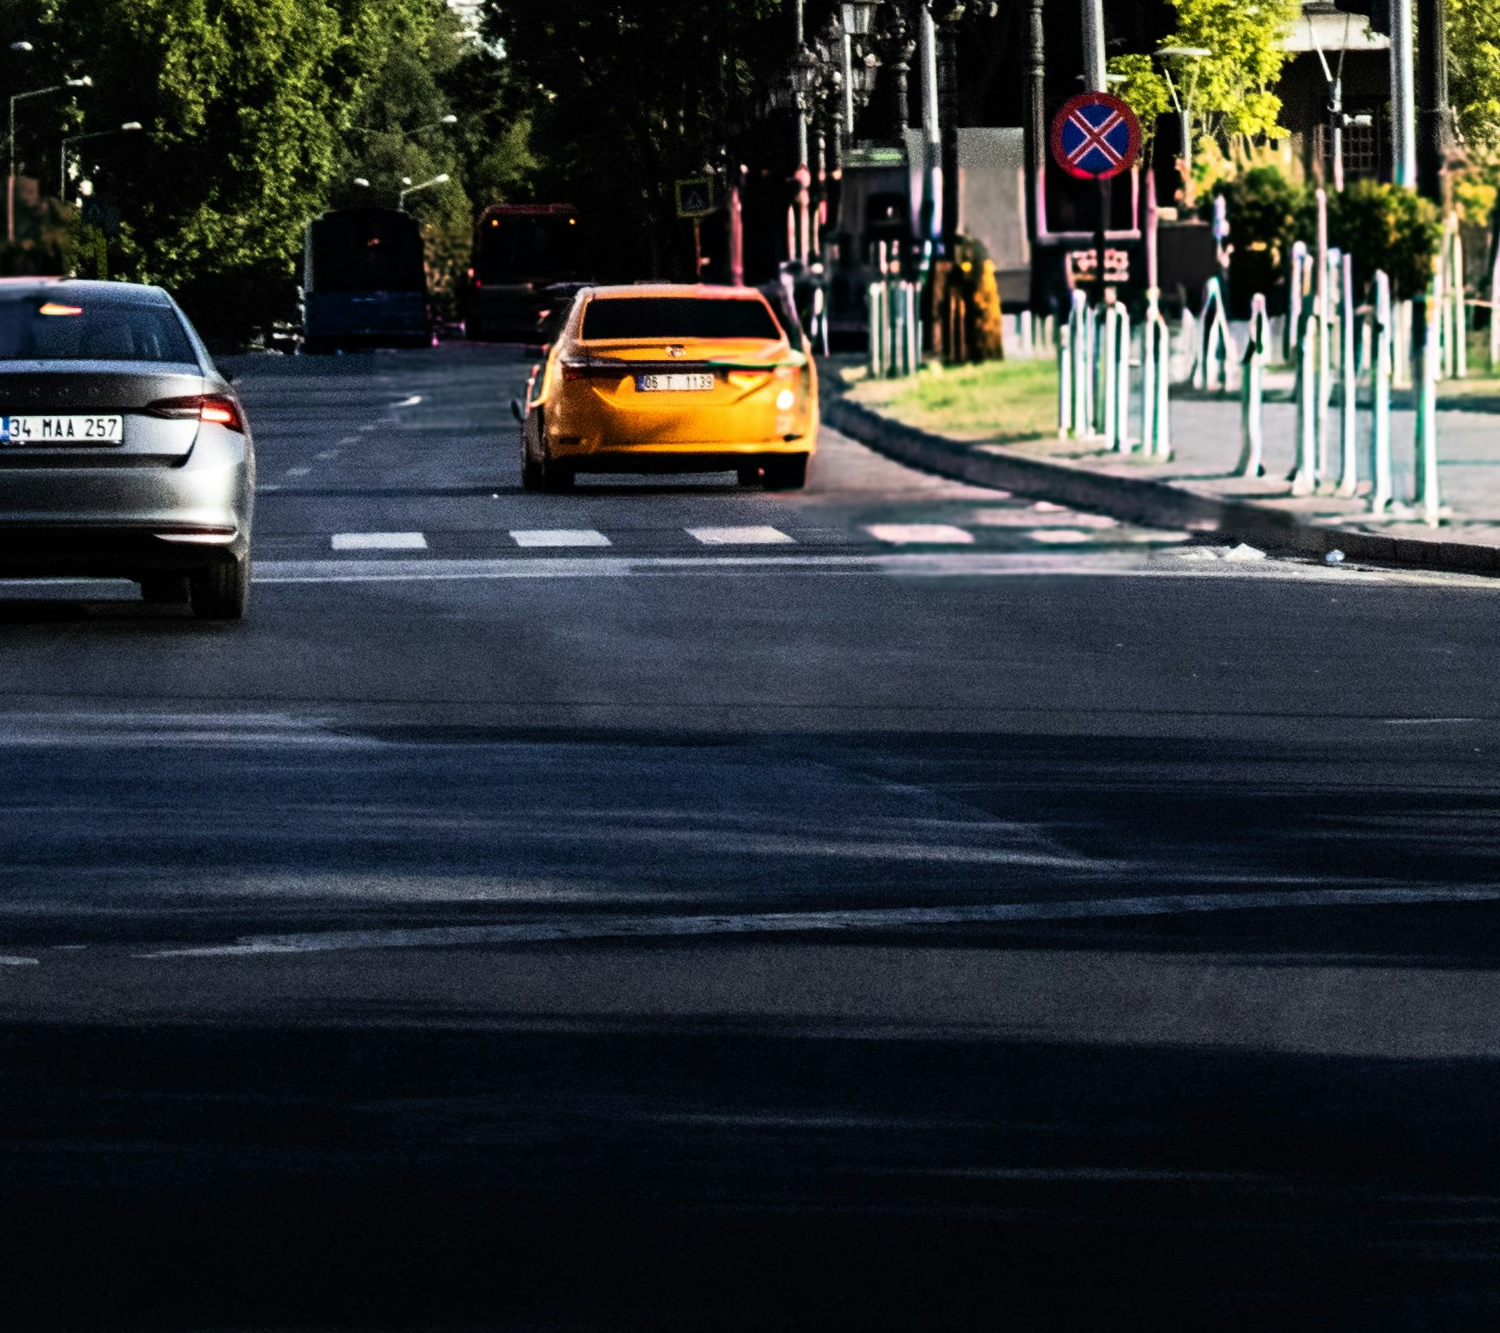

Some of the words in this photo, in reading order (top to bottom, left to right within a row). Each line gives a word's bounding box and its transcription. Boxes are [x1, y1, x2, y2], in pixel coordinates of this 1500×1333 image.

[666, 375, 674, 389] T
[686, 375, 713, 389] 1139
[10, 418, 32, 438] 34
[42, 418, 75, 438] MAA
[85, 418, 118, 437] 257
